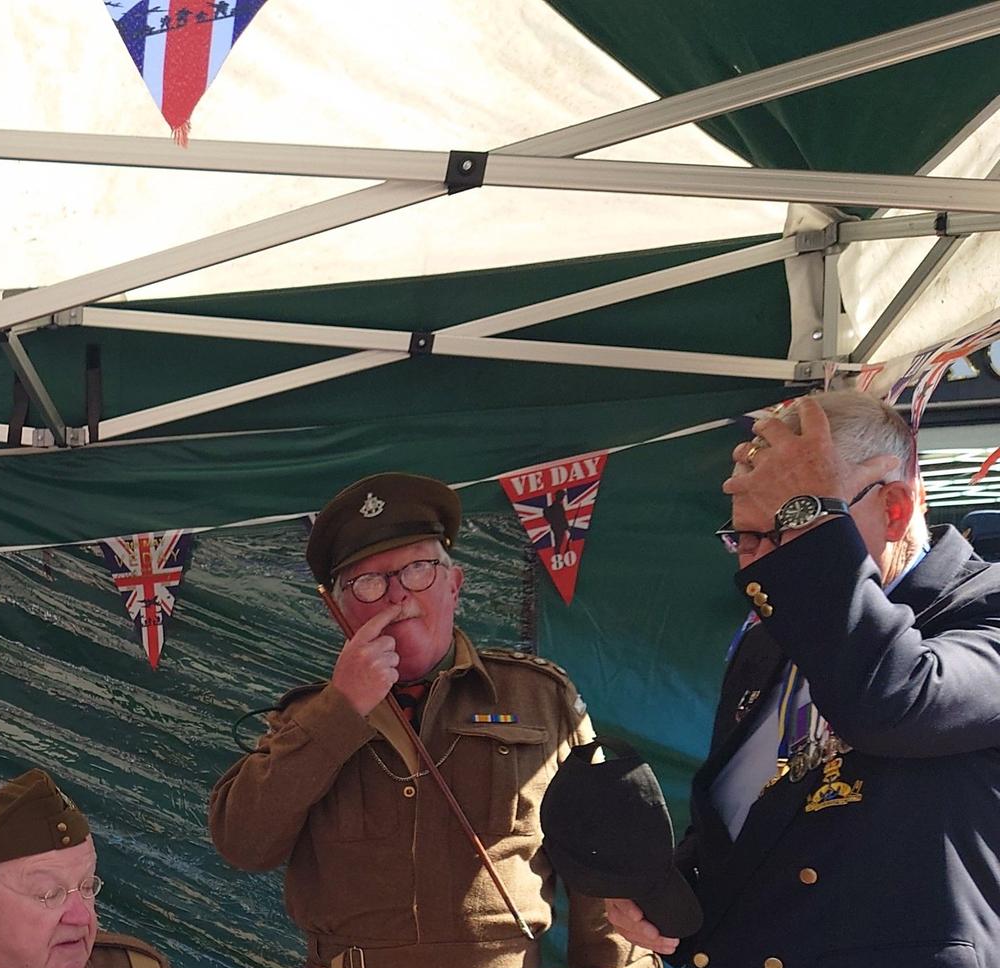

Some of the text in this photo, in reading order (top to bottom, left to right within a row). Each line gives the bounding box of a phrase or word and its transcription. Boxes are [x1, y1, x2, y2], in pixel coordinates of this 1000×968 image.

[510, 457, 600, 496] VE DAY
[551, 550, 577, 571] 80
